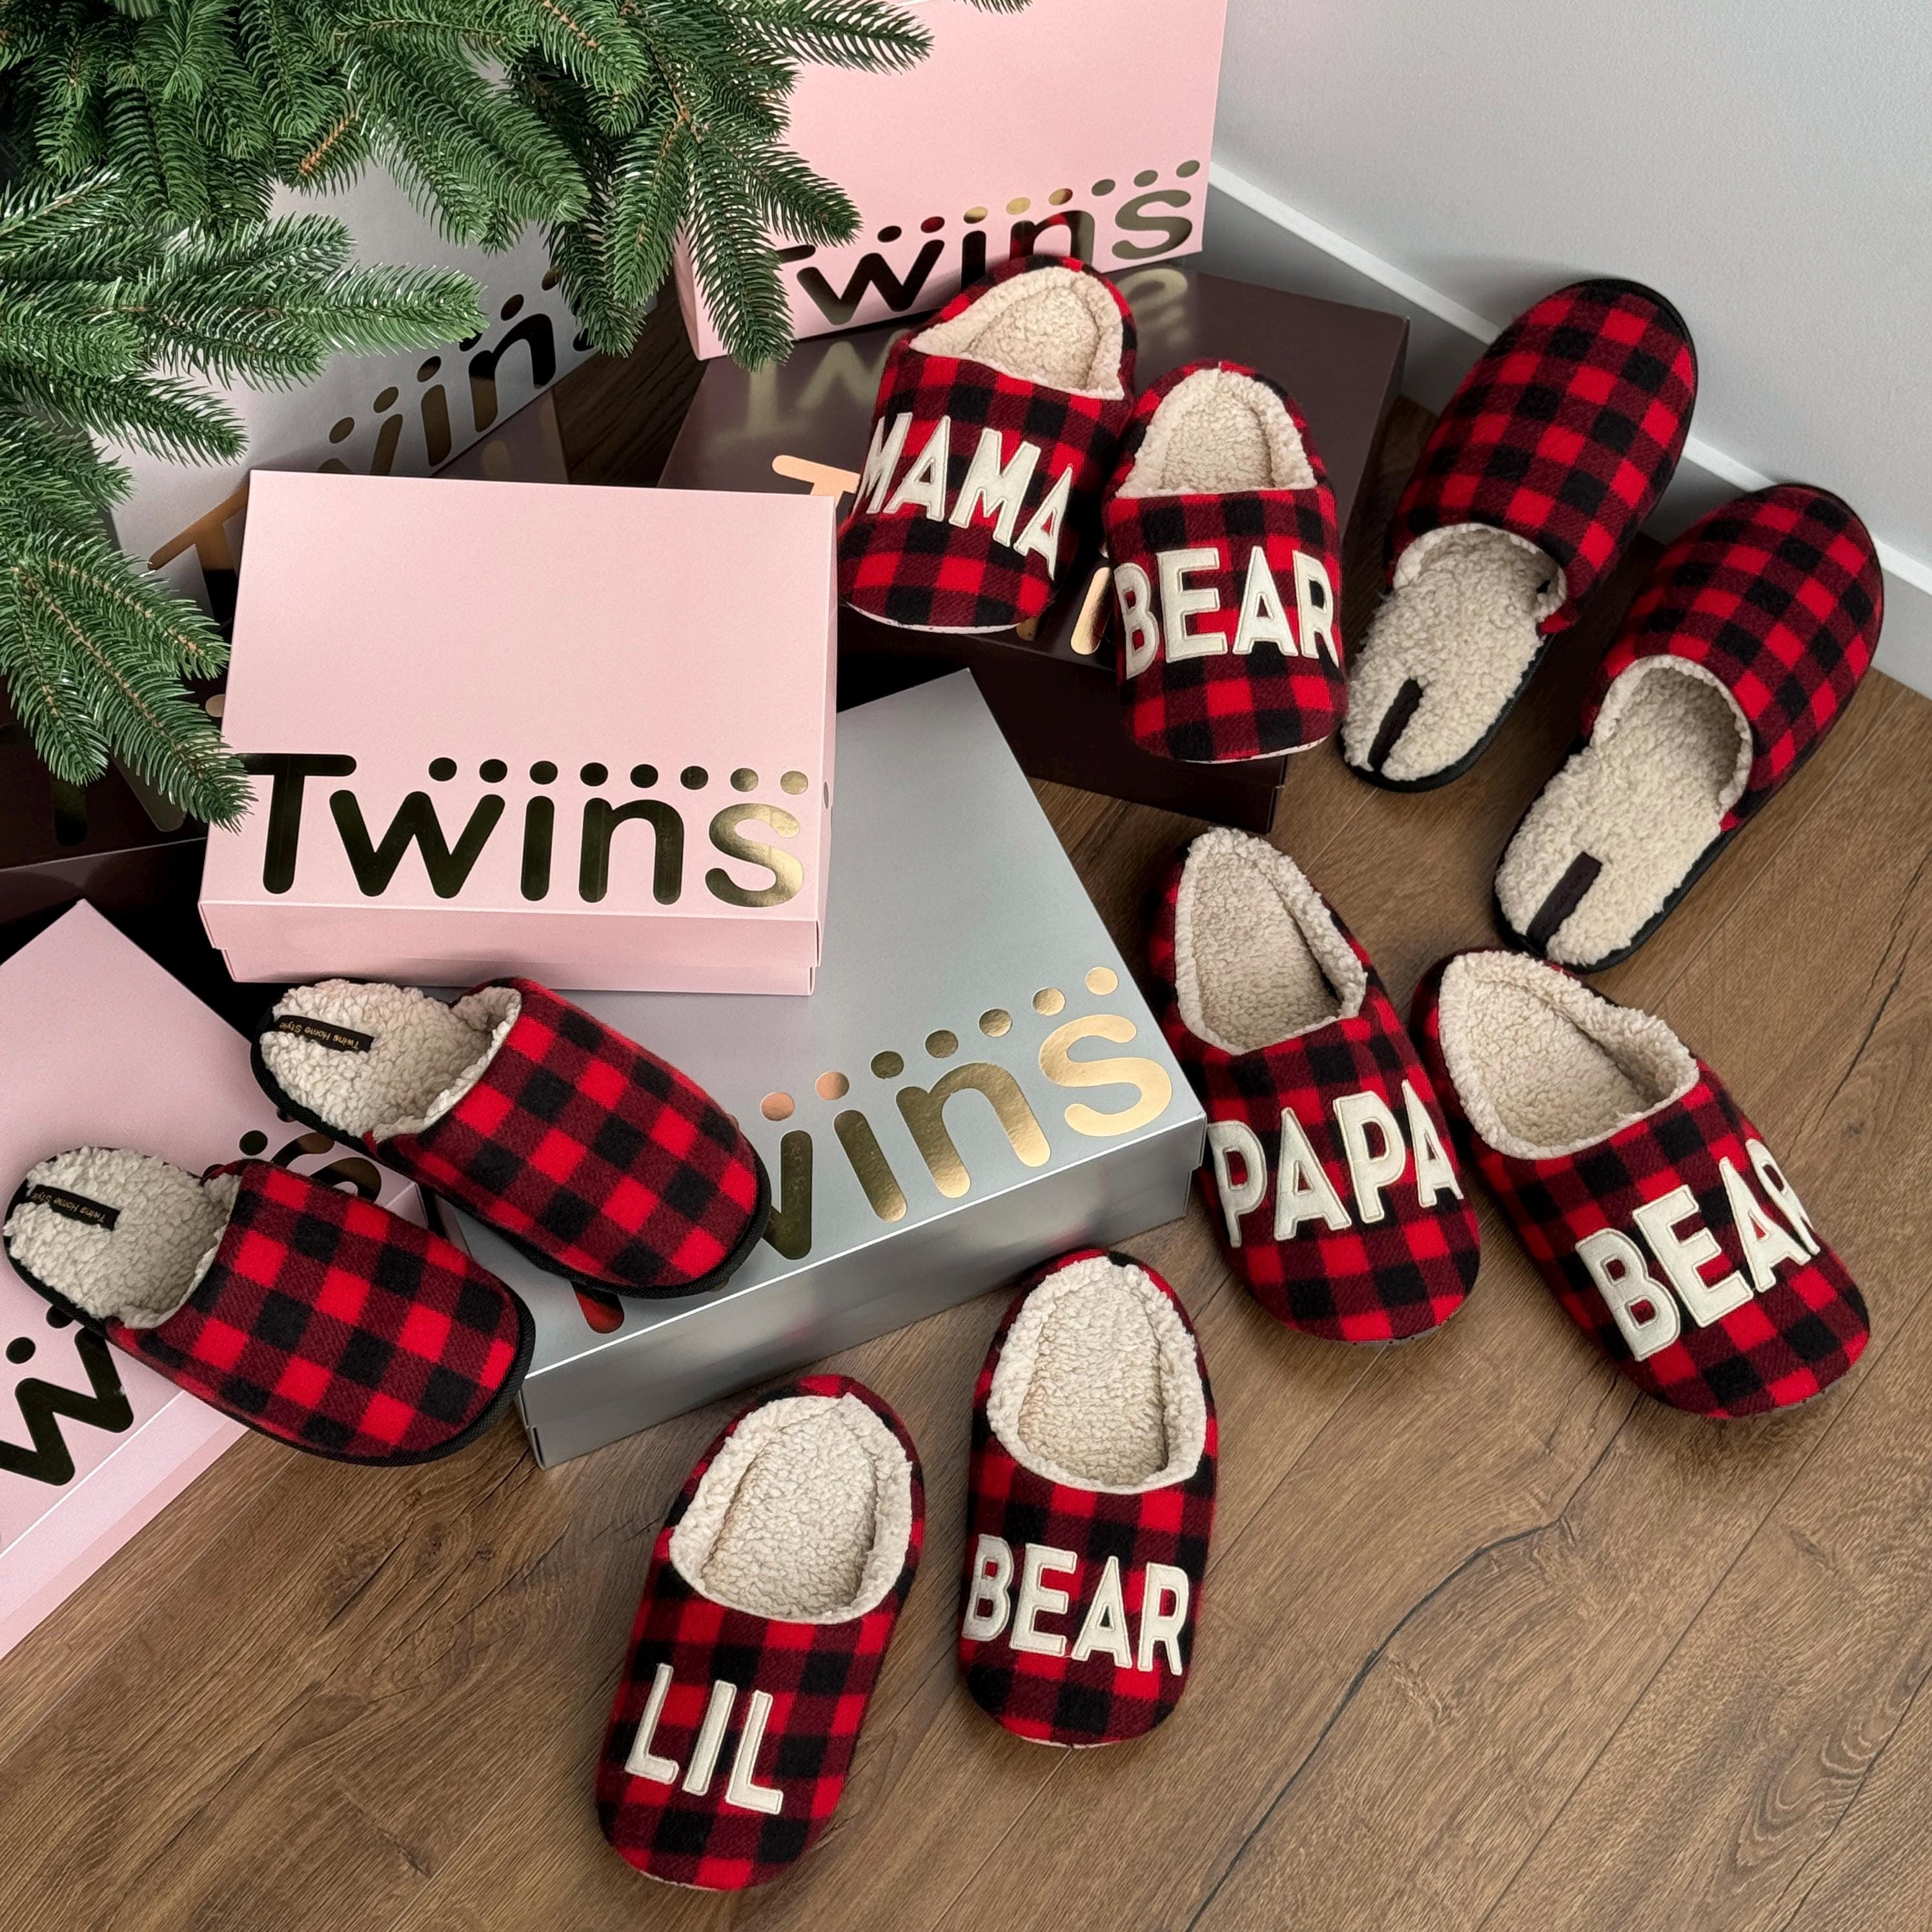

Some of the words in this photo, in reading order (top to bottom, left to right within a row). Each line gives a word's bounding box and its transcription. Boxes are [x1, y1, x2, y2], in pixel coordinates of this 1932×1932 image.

[852, 412, 1075, 580] MAMA
[1113, 545, 1339, 680] BEAR
[234, 754, 804, 907] Twins
[280, 1022, 301, 1033] Style
[305, 1026, 331, 1040] Home
[333, 1035, 359, 1049] Twins
[54, 1197, 80, 1211] Home
[81, 1207, 106, 1222] Twins
[1207, 1080, 1463, 1248] PAPA
[1575, 1139, 1821, 1361] BEAR
[962, 1534, 1190, 1676] BEAR
[624, 1663, 784, 1815] LIL
